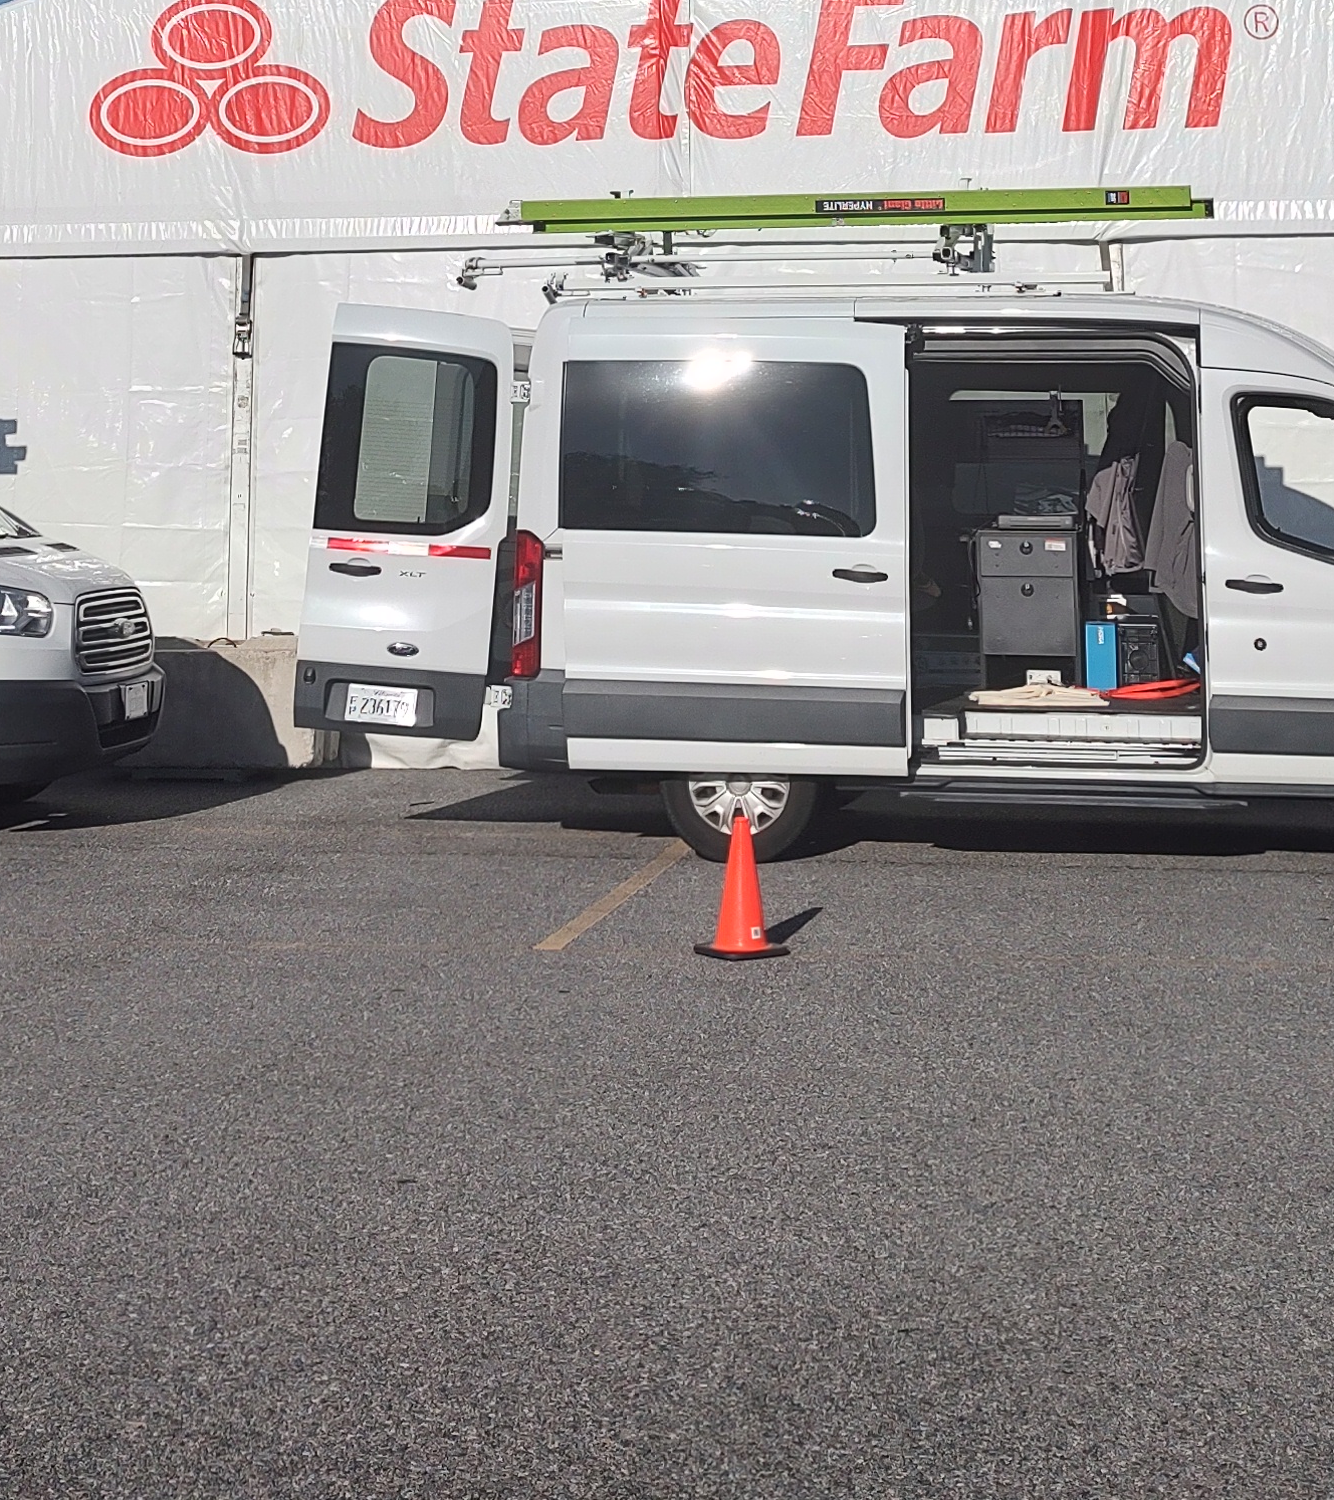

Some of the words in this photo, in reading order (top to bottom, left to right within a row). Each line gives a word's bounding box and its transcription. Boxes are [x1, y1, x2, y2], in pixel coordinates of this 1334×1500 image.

[822, 200, 873, 211] HYPERLITE
[883, 199, 912, 211] Giant
[399, 570, 427, 578] XLT
